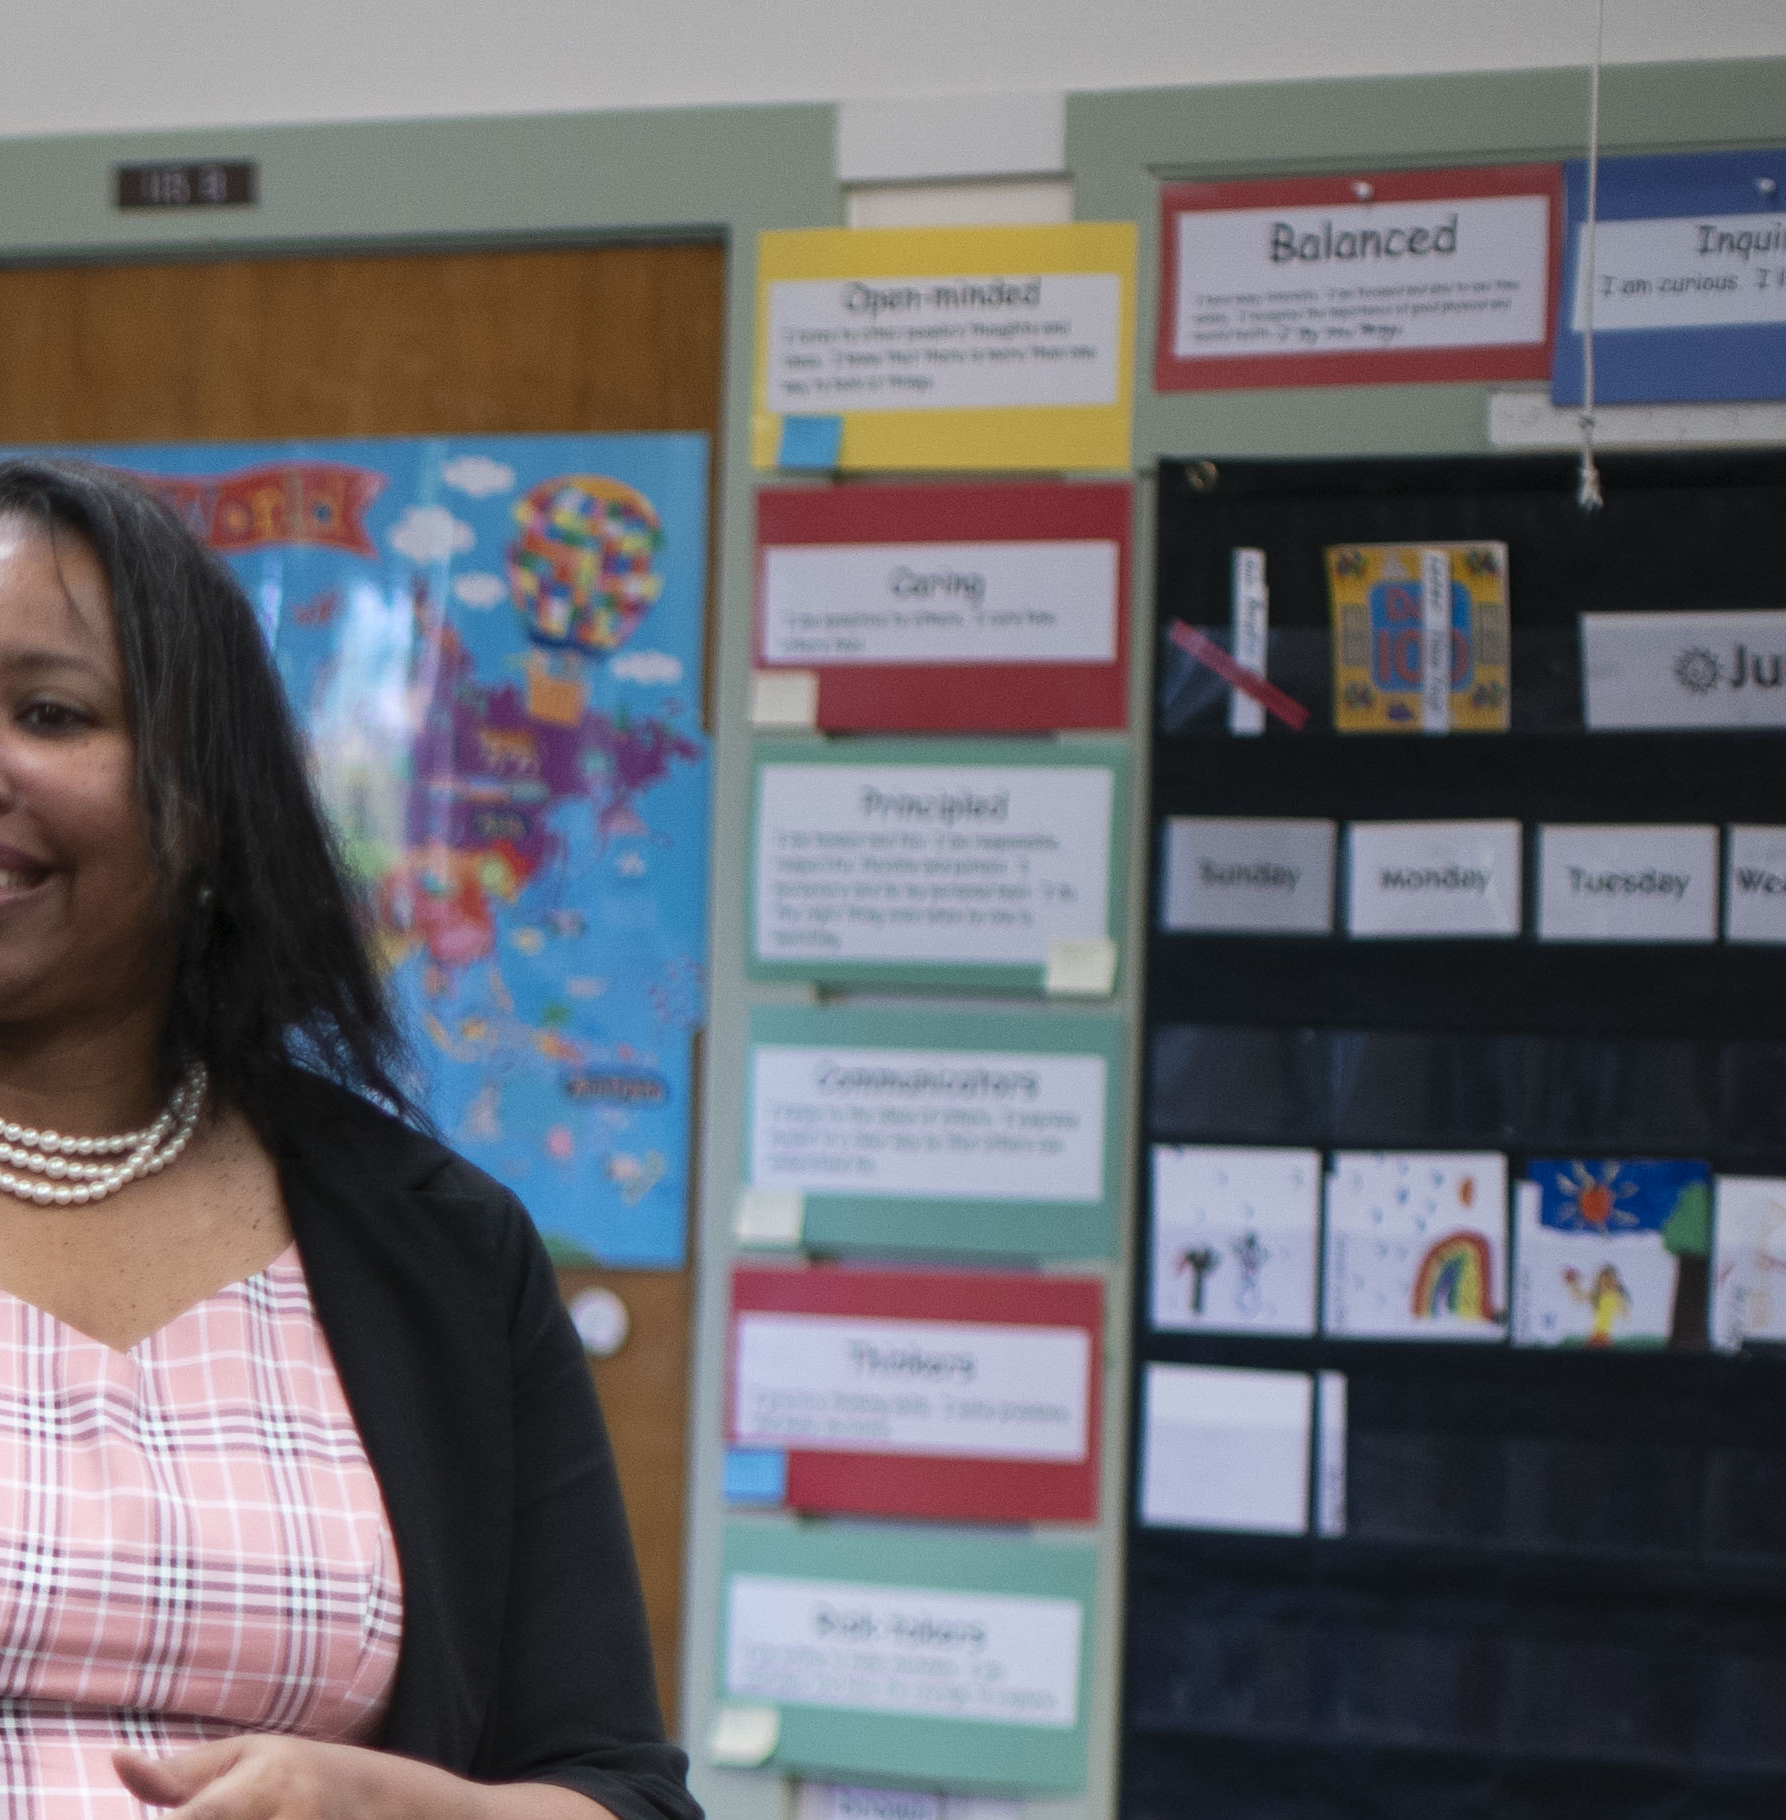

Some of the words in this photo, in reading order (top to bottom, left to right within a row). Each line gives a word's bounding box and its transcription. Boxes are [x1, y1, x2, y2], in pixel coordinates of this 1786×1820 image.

[1269, 211, 1460, 264] Balanced
[841, 276, 1043, 318] Open-minded
[1623, 279, 1653, 295] am
[890, 565, 988, 609] Caring
[861, 783, 1011, 827] Principled
[1199, 860, 1302, 895] Sunday
[1380, 863, 1492, 896] Monday
[1566, 865, 1691, 902] Tuesday
[816, 1059, 1041, 1099] Communicators
